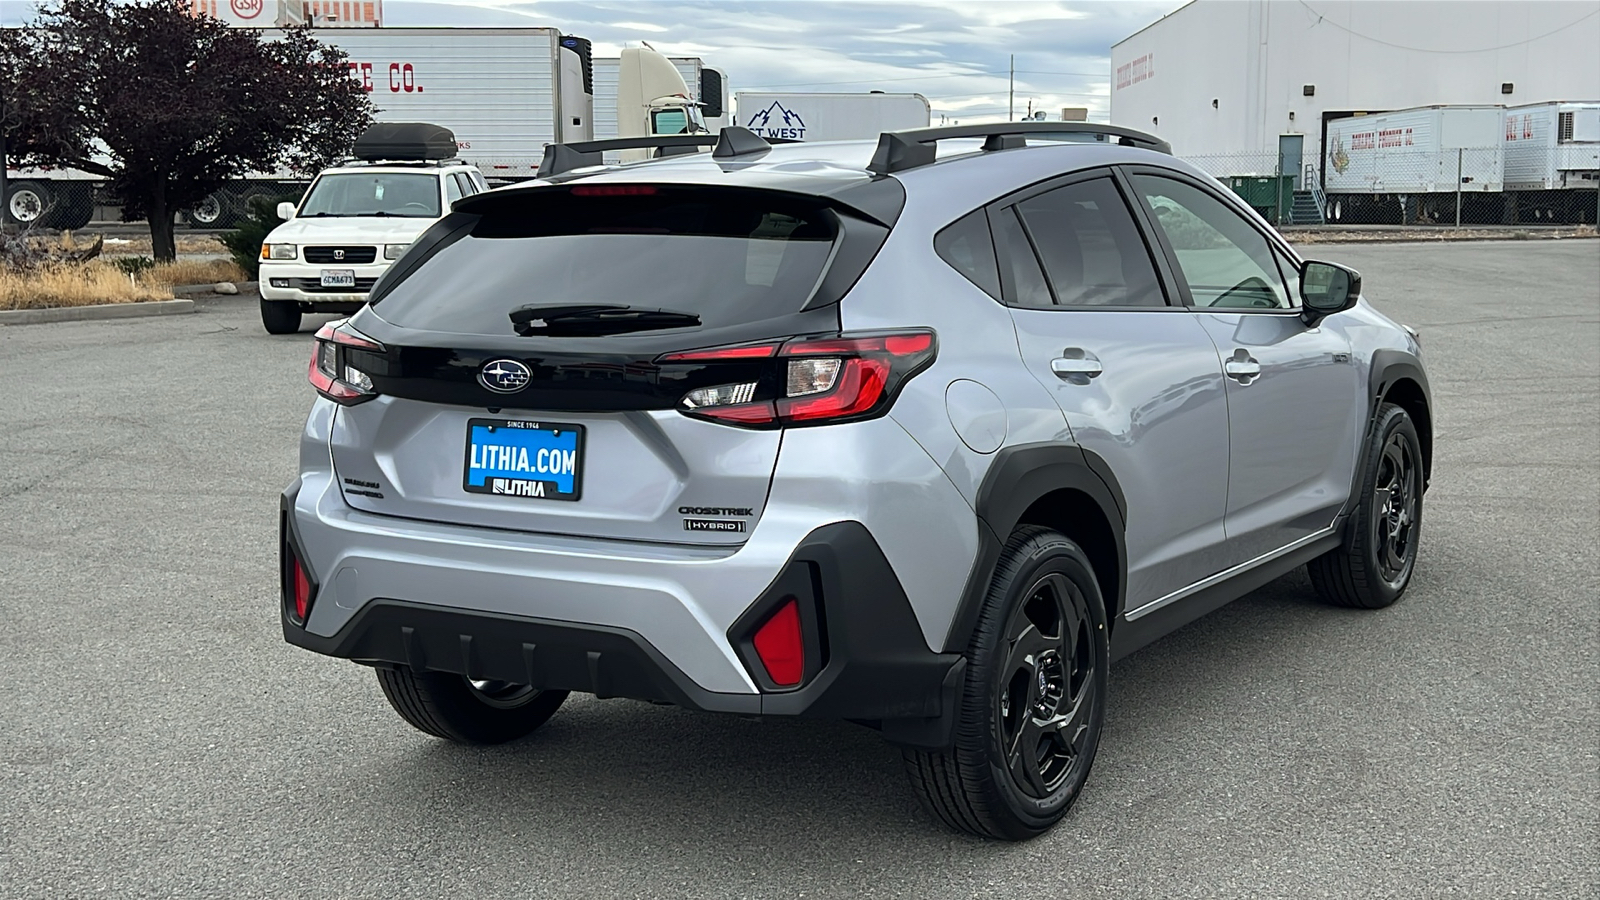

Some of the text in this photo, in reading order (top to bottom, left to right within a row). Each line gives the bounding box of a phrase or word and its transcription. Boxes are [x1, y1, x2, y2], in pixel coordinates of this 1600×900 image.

[234, 0, 259, 10] GSR
[389, 62, 424, 93] CO.
[767, 128, 806, 138] WEST
[507, 421, 540, 430] SINCE 1946
[470, 443, 576, 476] LITHIA.COM
[504, 479, 545, 497] LITHIA
[678, 506, 753, 517] CROSSTREK
[692, 521, 736, 530] HYBRID
